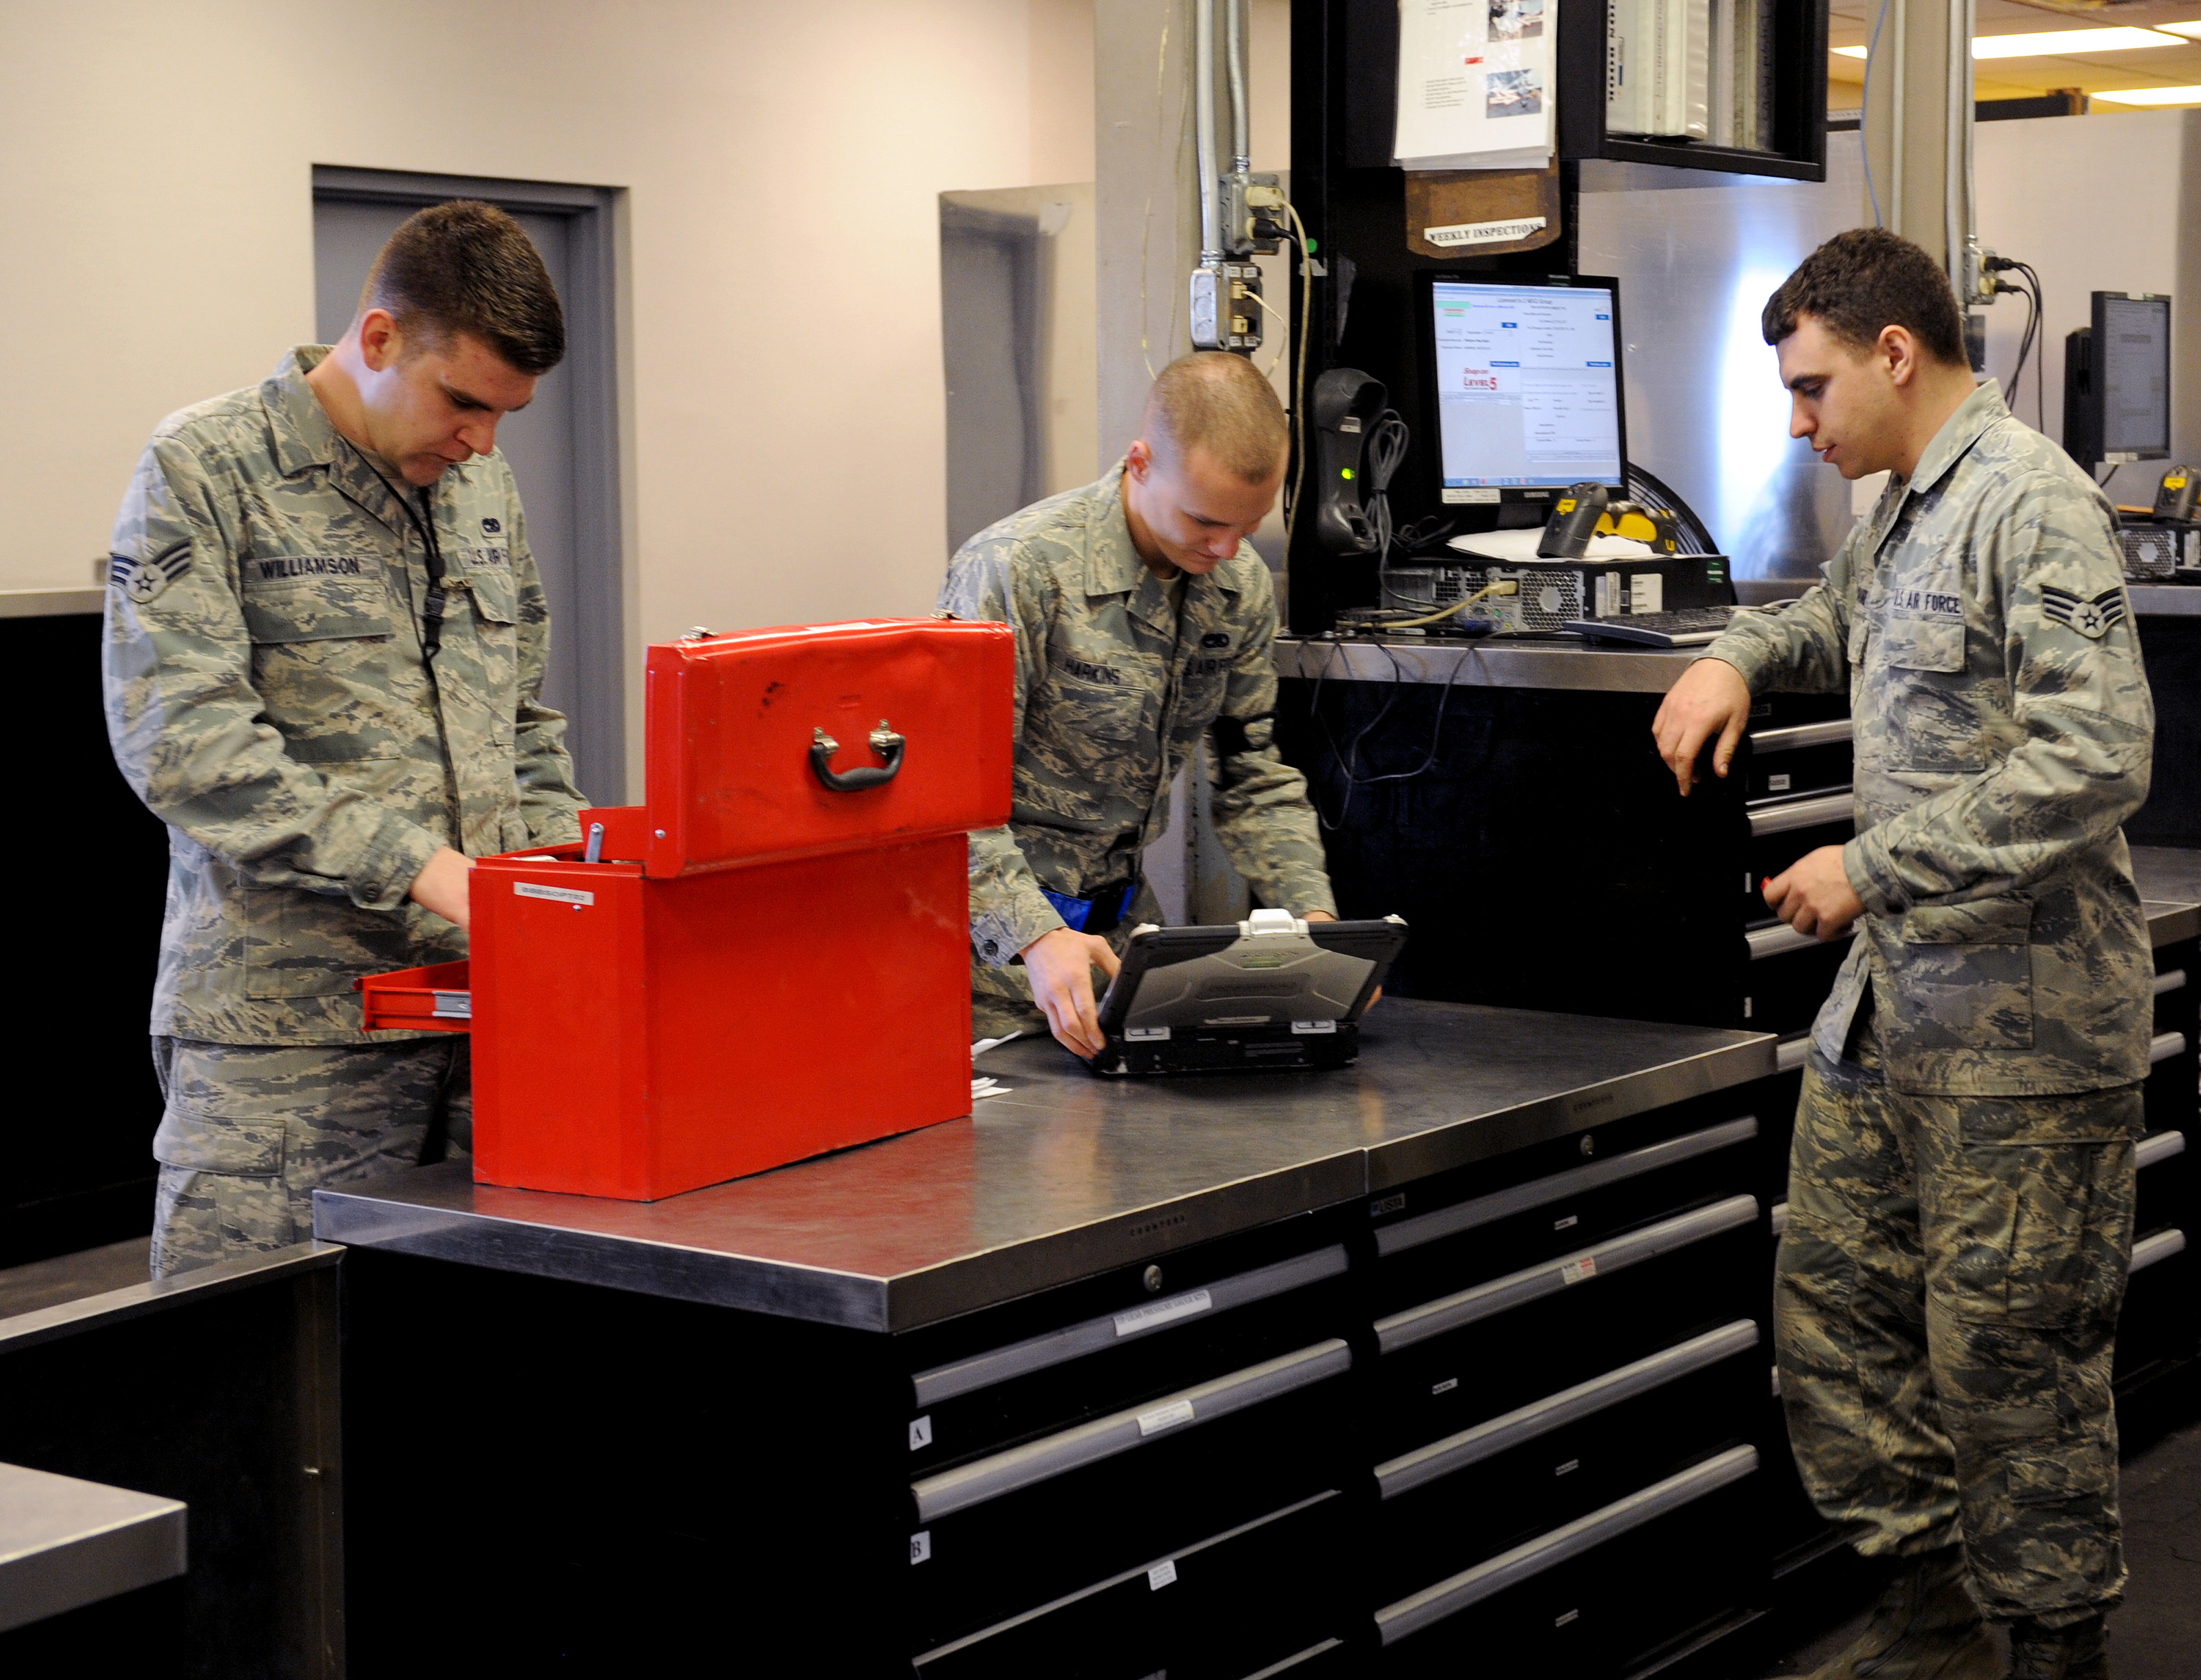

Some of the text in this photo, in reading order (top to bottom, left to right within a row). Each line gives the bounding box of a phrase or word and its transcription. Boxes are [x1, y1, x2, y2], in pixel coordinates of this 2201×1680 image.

[1430, 229, 1470, 242] WEEKLY
[260, 556, 360, 578] WILLIAMSON
[1925, 594, 1961, 613] FORCE
[912, 1427, 924, 1445] A
[910, 1541, 921, 1558] B
